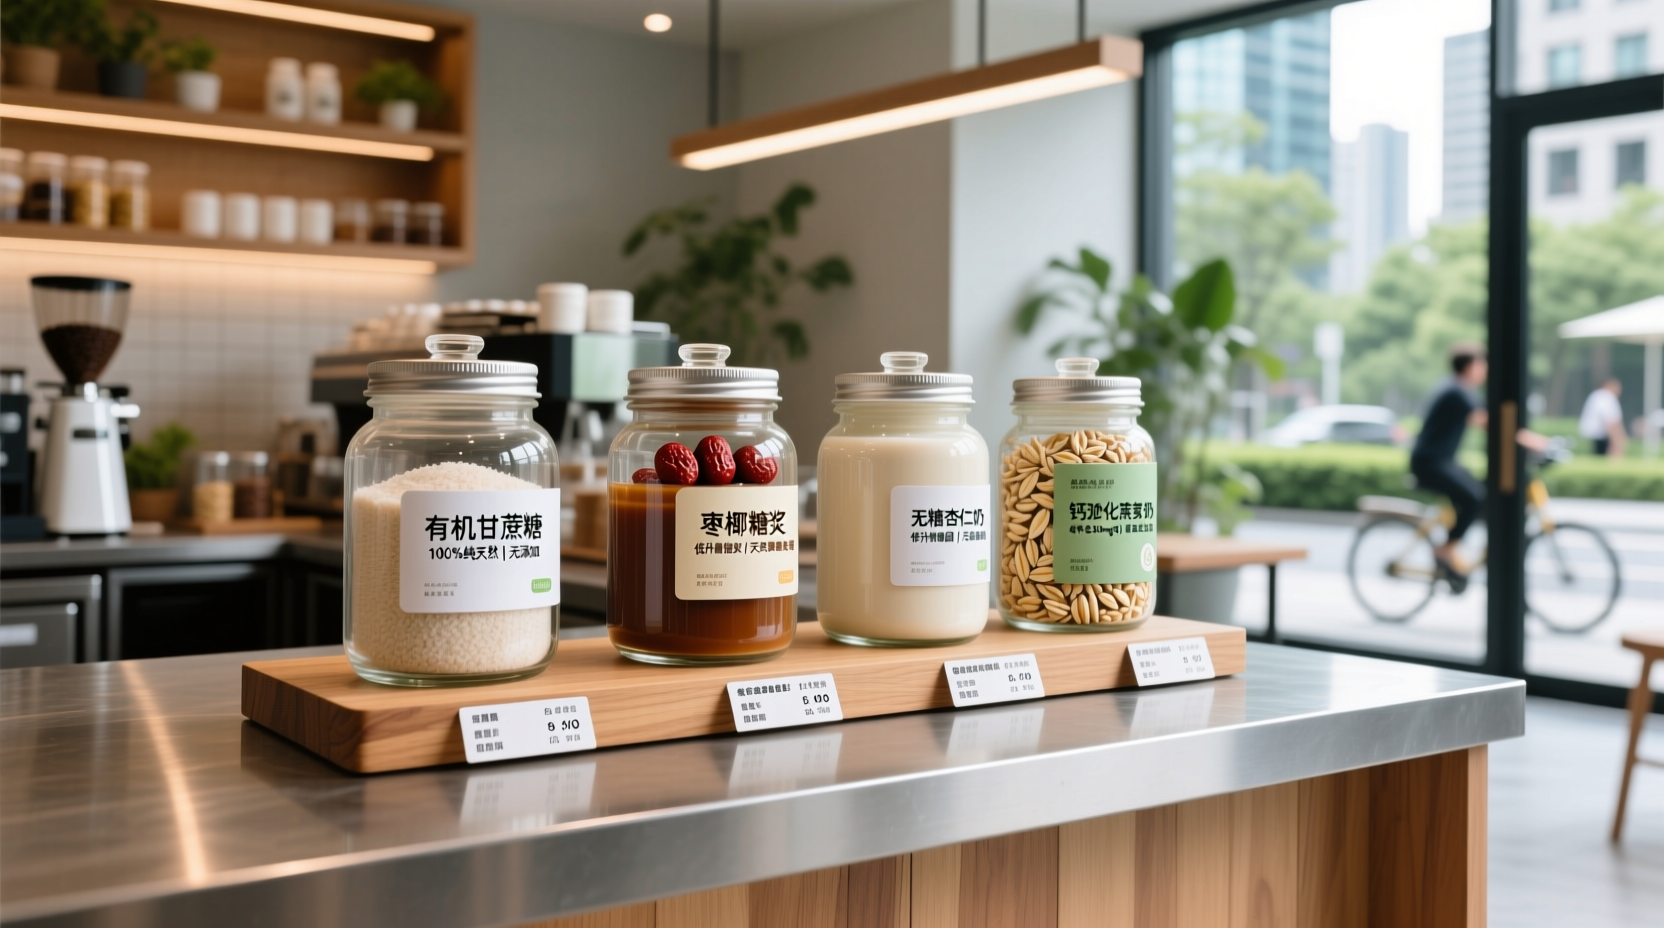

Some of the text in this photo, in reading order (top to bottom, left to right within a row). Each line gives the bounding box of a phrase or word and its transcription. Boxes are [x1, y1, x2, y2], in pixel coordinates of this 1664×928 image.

[424, 512, 543, 541] 有机甘蔗糖
[911, 507, 984, 528] 无糖杏仁奶
